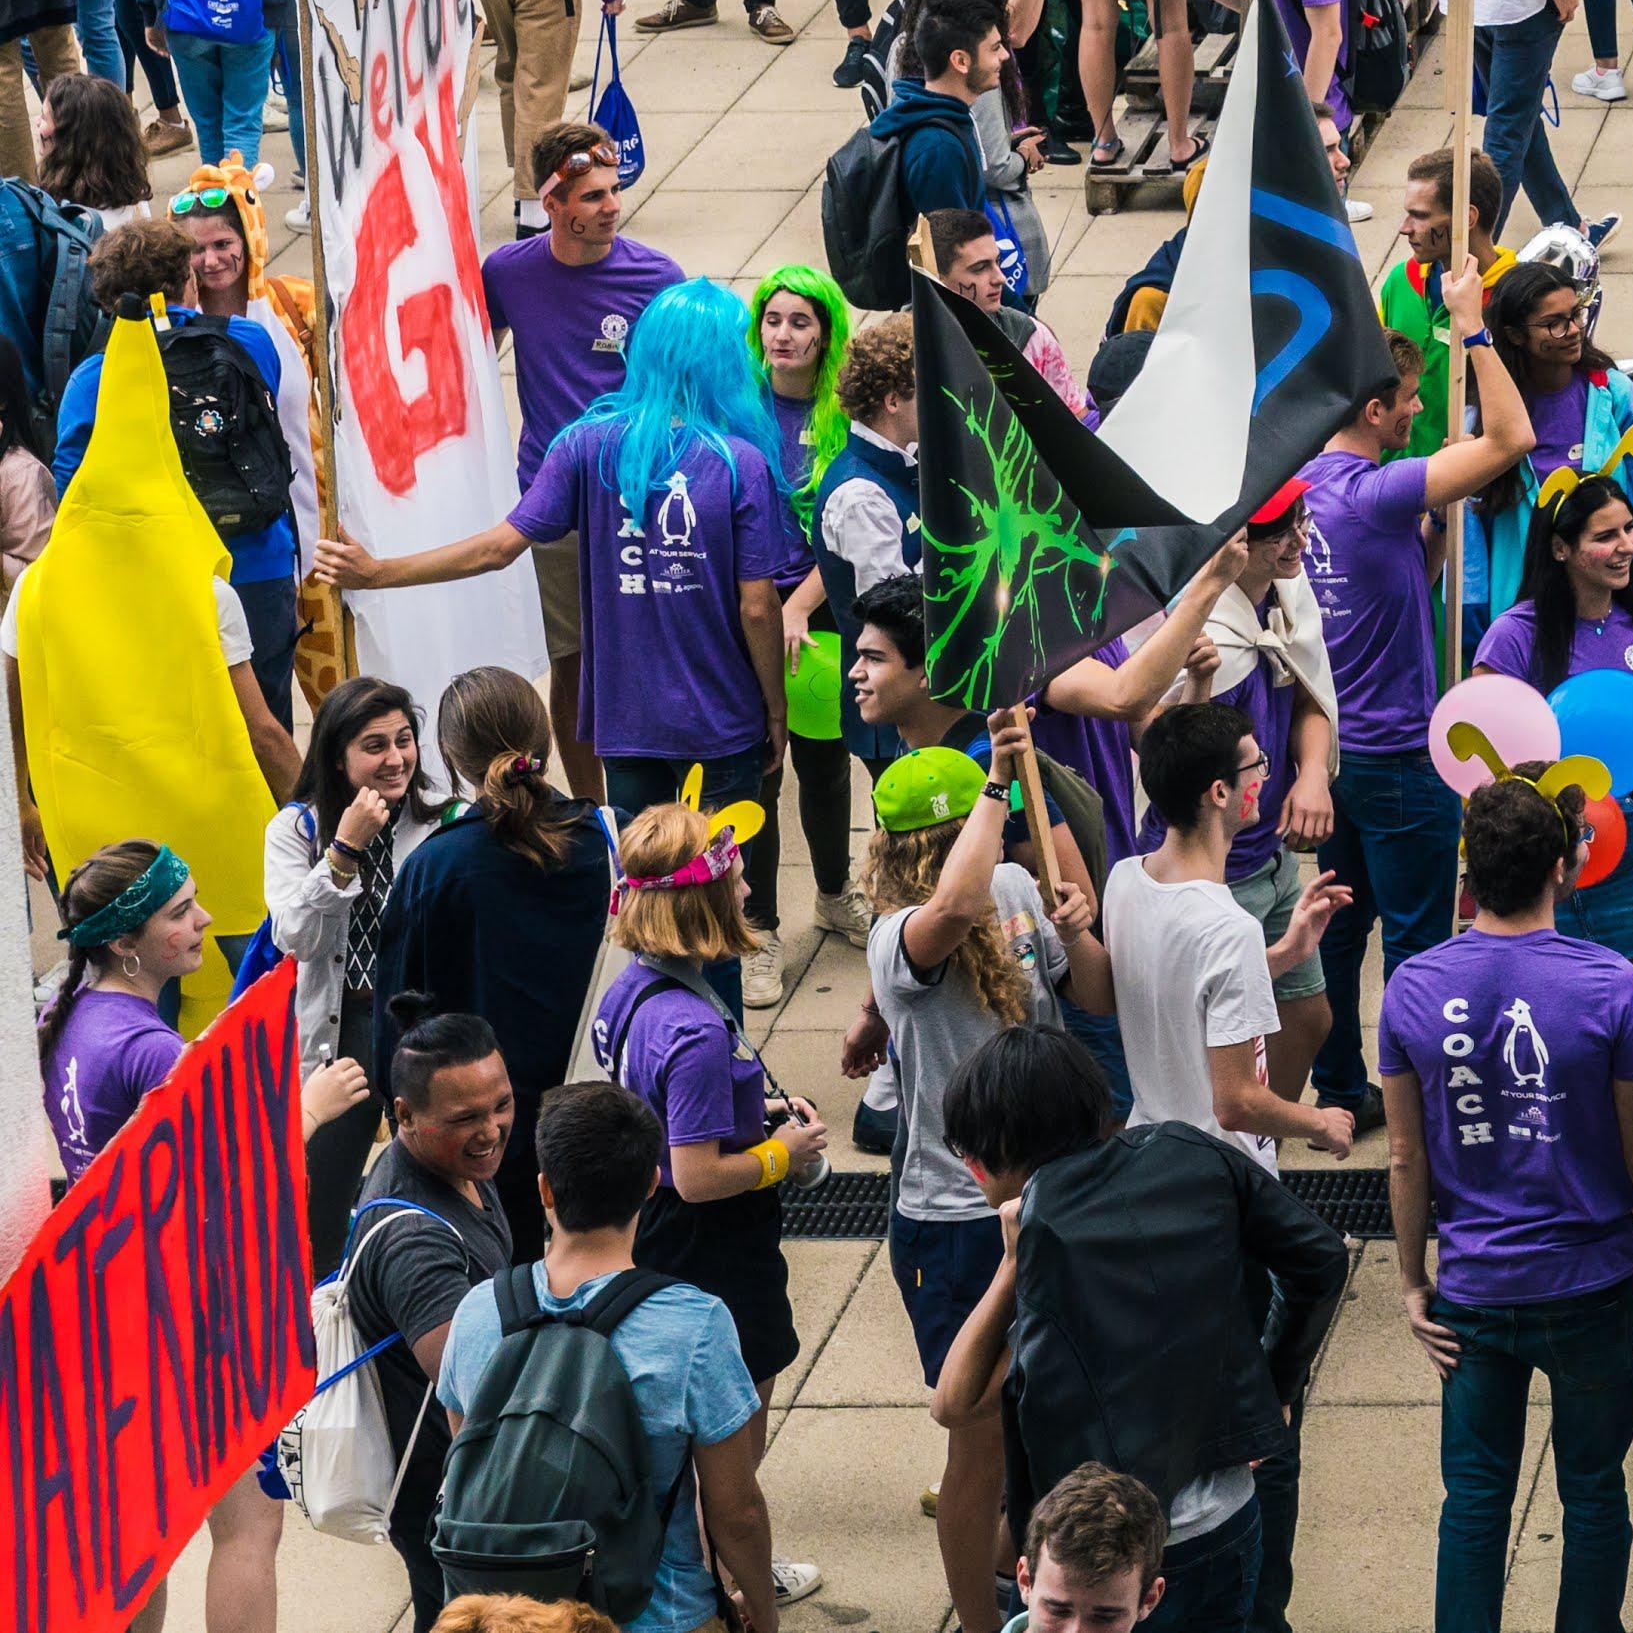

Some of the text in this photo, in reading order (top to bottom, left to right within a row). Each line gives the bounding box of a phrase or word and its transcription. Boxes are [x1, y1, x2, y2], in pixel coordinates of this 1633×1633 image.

[679, 551, 708, 561] SERVICE
[1442, 997, 1495, 1146] COACH
[1511, 1090, 1534, 1100] YOUR
